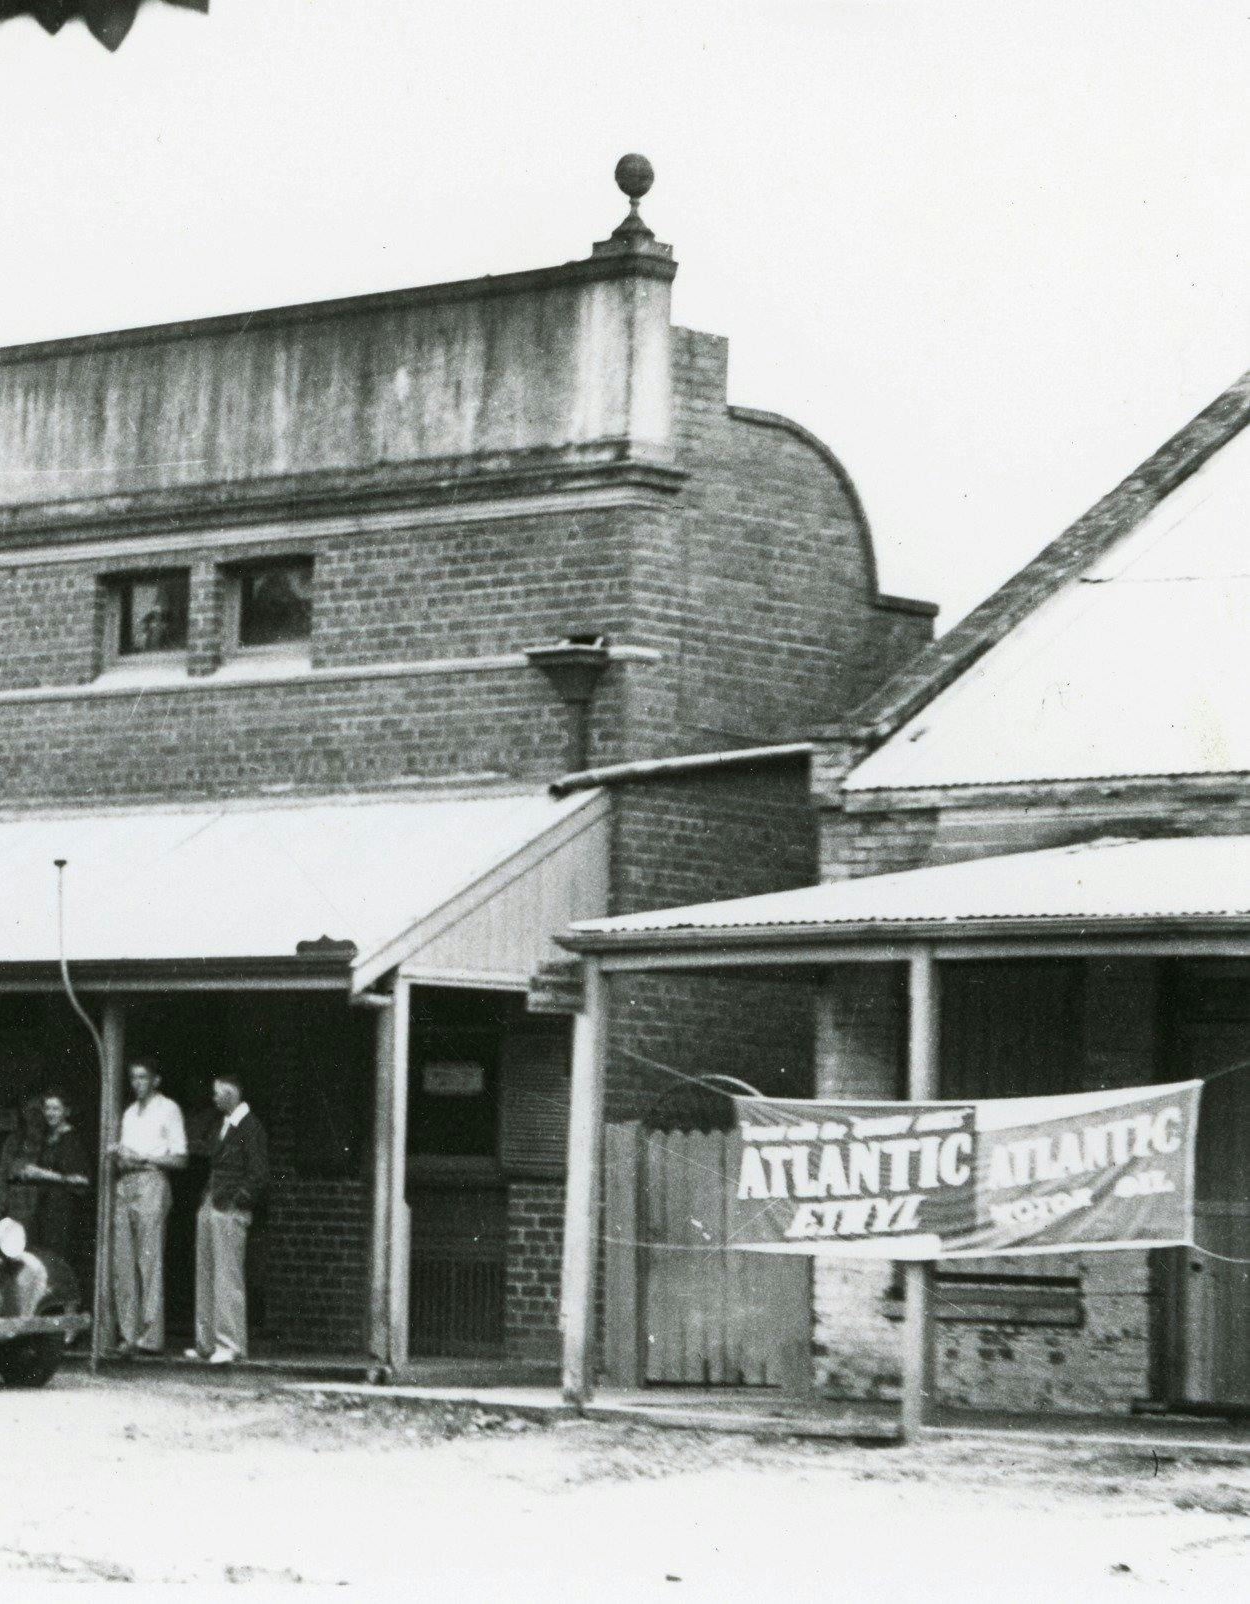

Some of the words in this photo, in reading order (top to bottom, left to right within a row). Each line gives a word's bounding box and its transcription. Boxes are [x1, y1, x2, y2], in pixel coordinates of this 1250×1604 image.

[737, 1133, 972, 1200] ATLANTIC
[984, 1107, 1182, 1191] ATLANTIC
[784, 1195, 927, 1237] ETHYL
